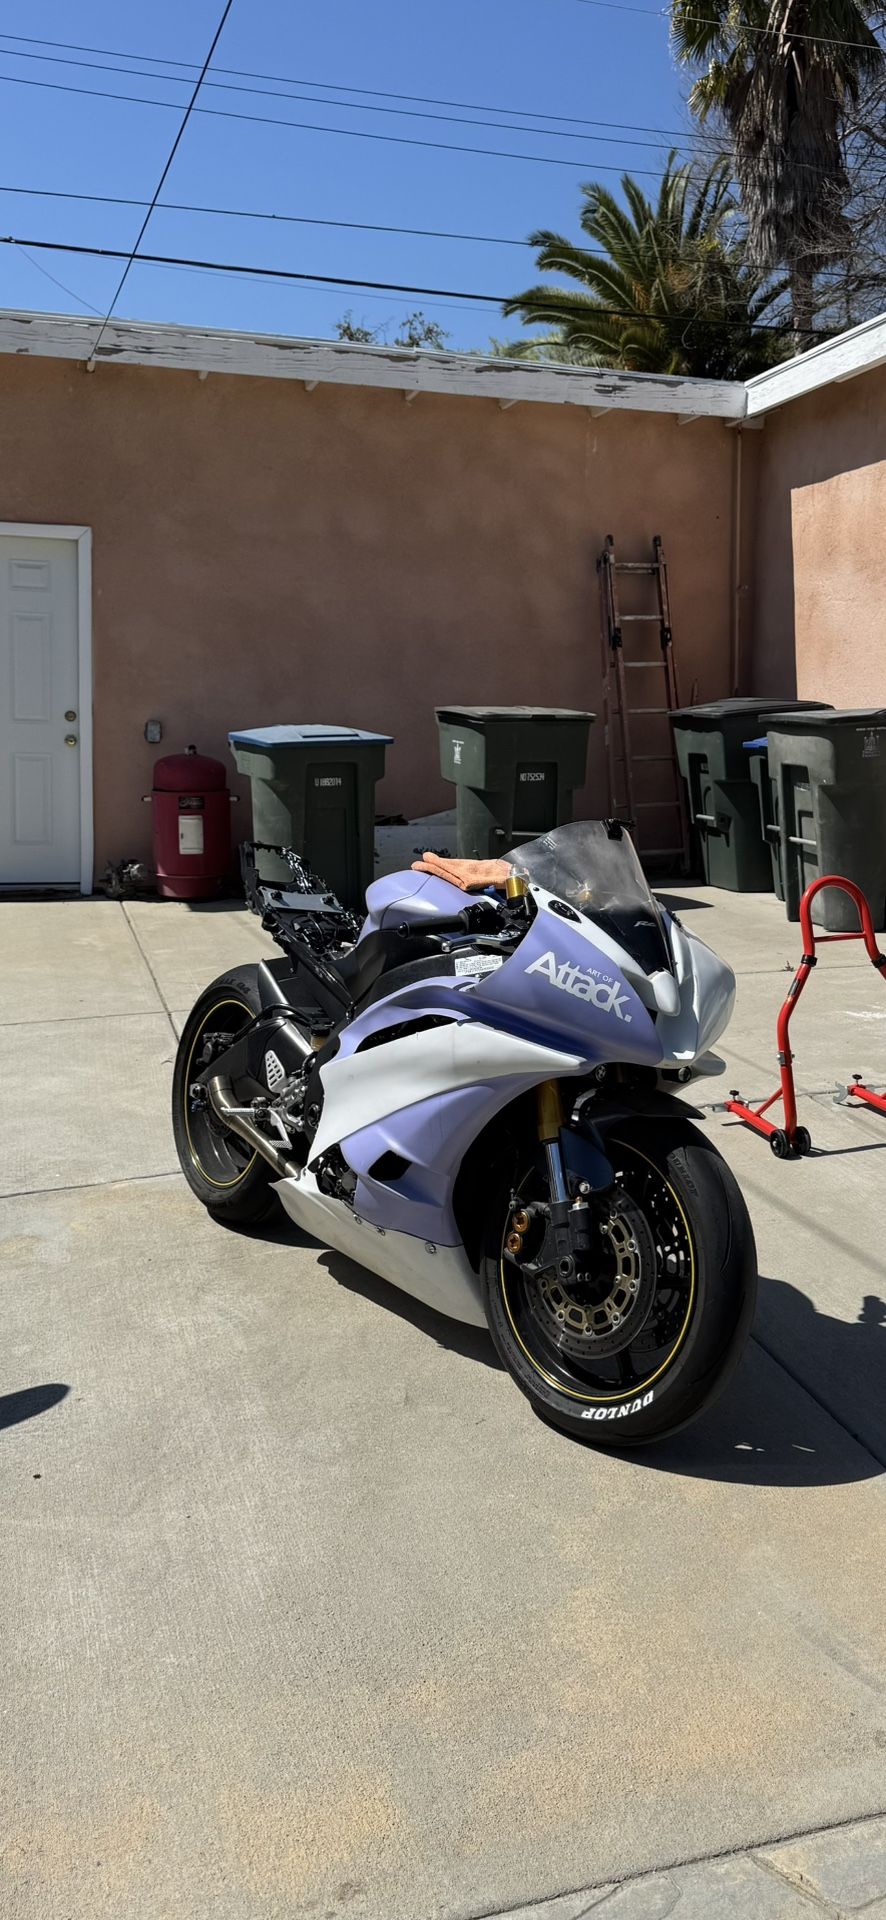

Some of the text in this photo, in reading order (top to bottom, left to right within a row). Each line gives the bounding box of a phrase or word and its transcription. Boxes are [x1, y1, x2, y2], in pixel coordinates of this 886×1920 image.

[524, 951, 632, 1023] Attack.
[586, 968, 614, 983] ART OF
[581, 1390, 654, 1420] DUNLOP
